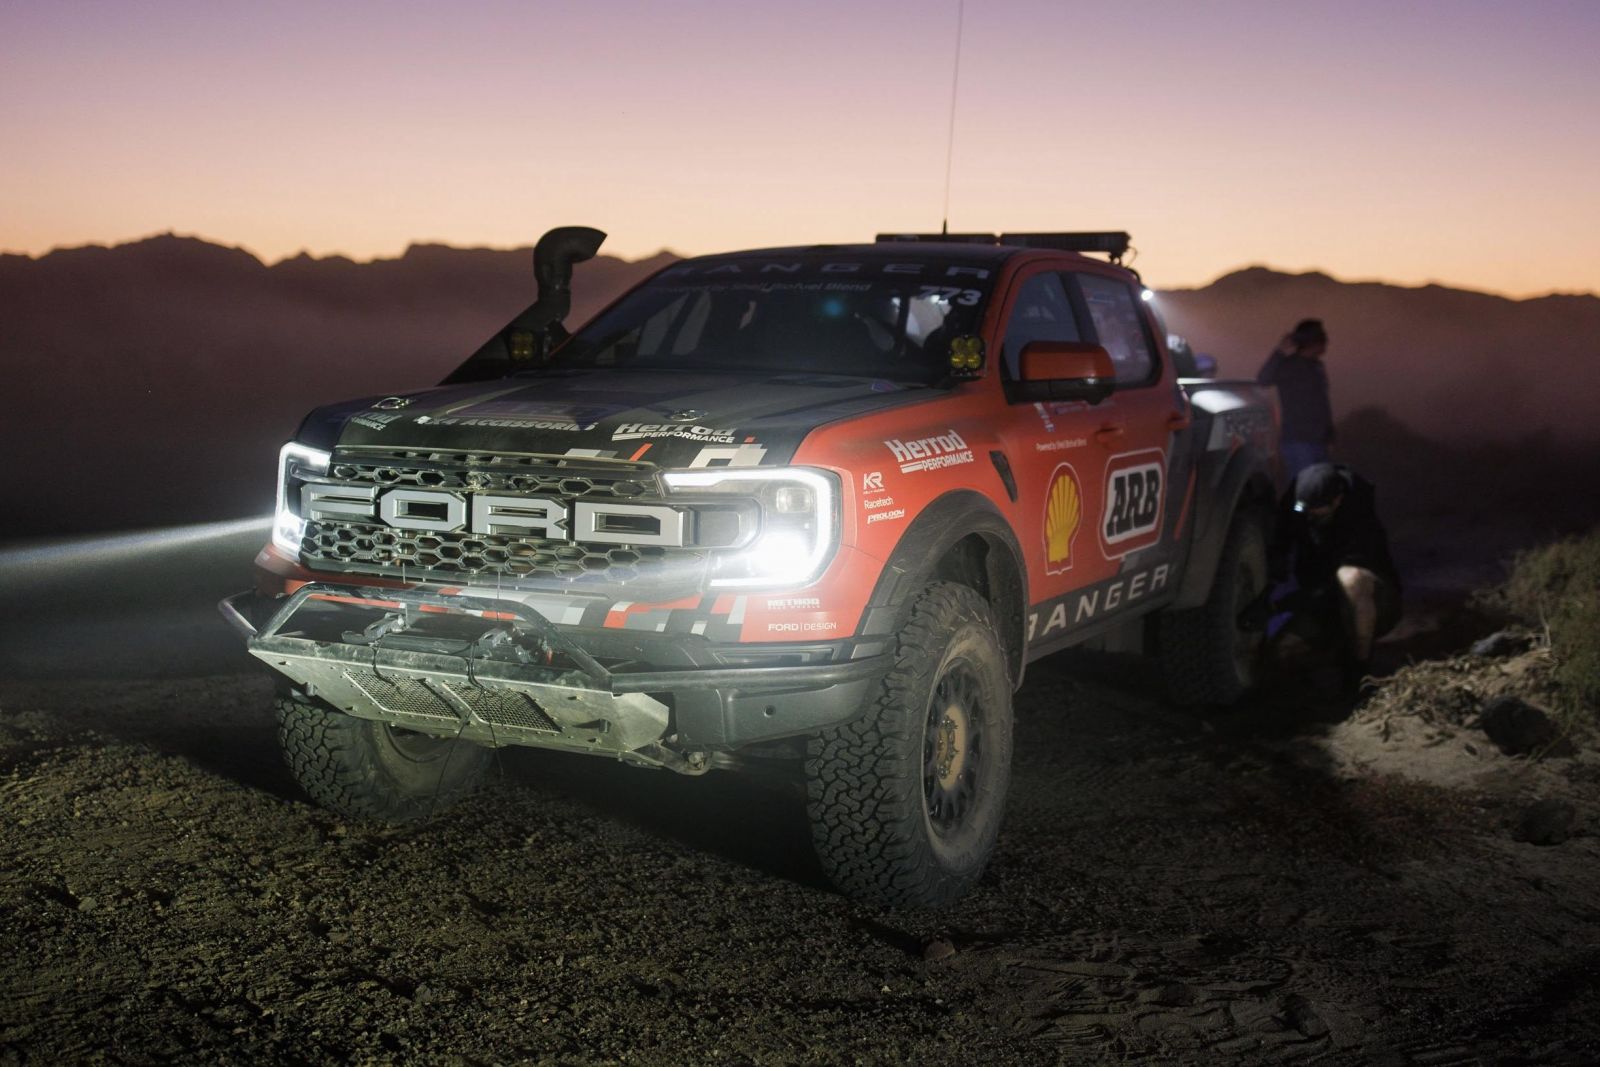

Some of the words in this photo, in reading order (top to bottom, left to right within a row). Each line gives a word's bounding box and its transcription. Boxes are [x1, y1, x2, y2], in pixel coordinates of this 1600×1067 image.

[919, 285, 983, 306] 773
[613, 423, 737, 436] Herrod
[640, 431, 735, 444] PERFORMANCE
[884, 429, 968, 462] Herrod
[922, 450, 974, 472] PERFORMANCE
[863, 471, 884, 490] KR
[864, 496, 894, 510] Racetech
[1106, 468, 1160, 537] ARB
[302, 484, 690, 547] FORD
[767, 623, 799, 631] FORD
[803, 622, 837, 631] DESIGN
